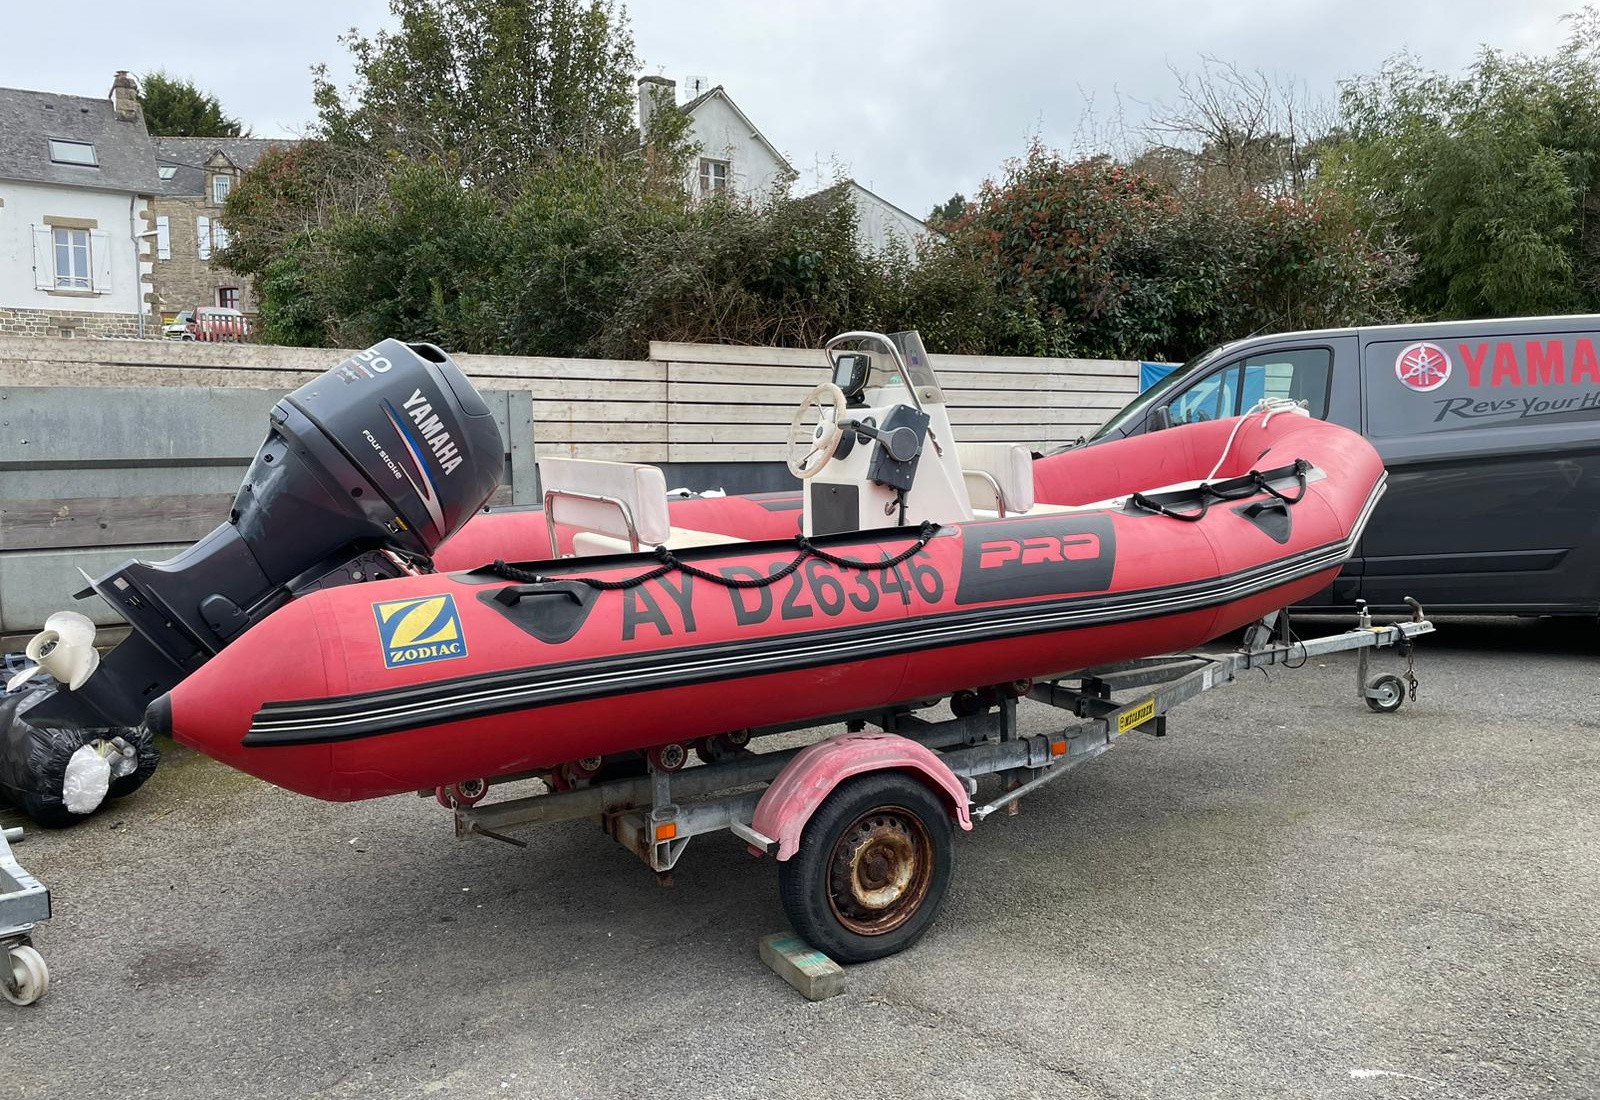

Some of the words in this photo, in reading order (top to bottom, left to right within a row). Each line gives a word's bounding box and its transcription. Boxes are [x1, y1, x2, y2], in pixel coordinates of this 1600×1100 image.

[1458, 338, 1600, 389] YAMA
[403, 388, 463, 476] YAMAHA
[1433, 397, 1518, 423] Revs
[1519, 396, 1580, 418] Your
[622, 566, 697, 641] AY
[719, 550, 945, 627] D26346
[390, 643, 461, 663] ZODIAC
